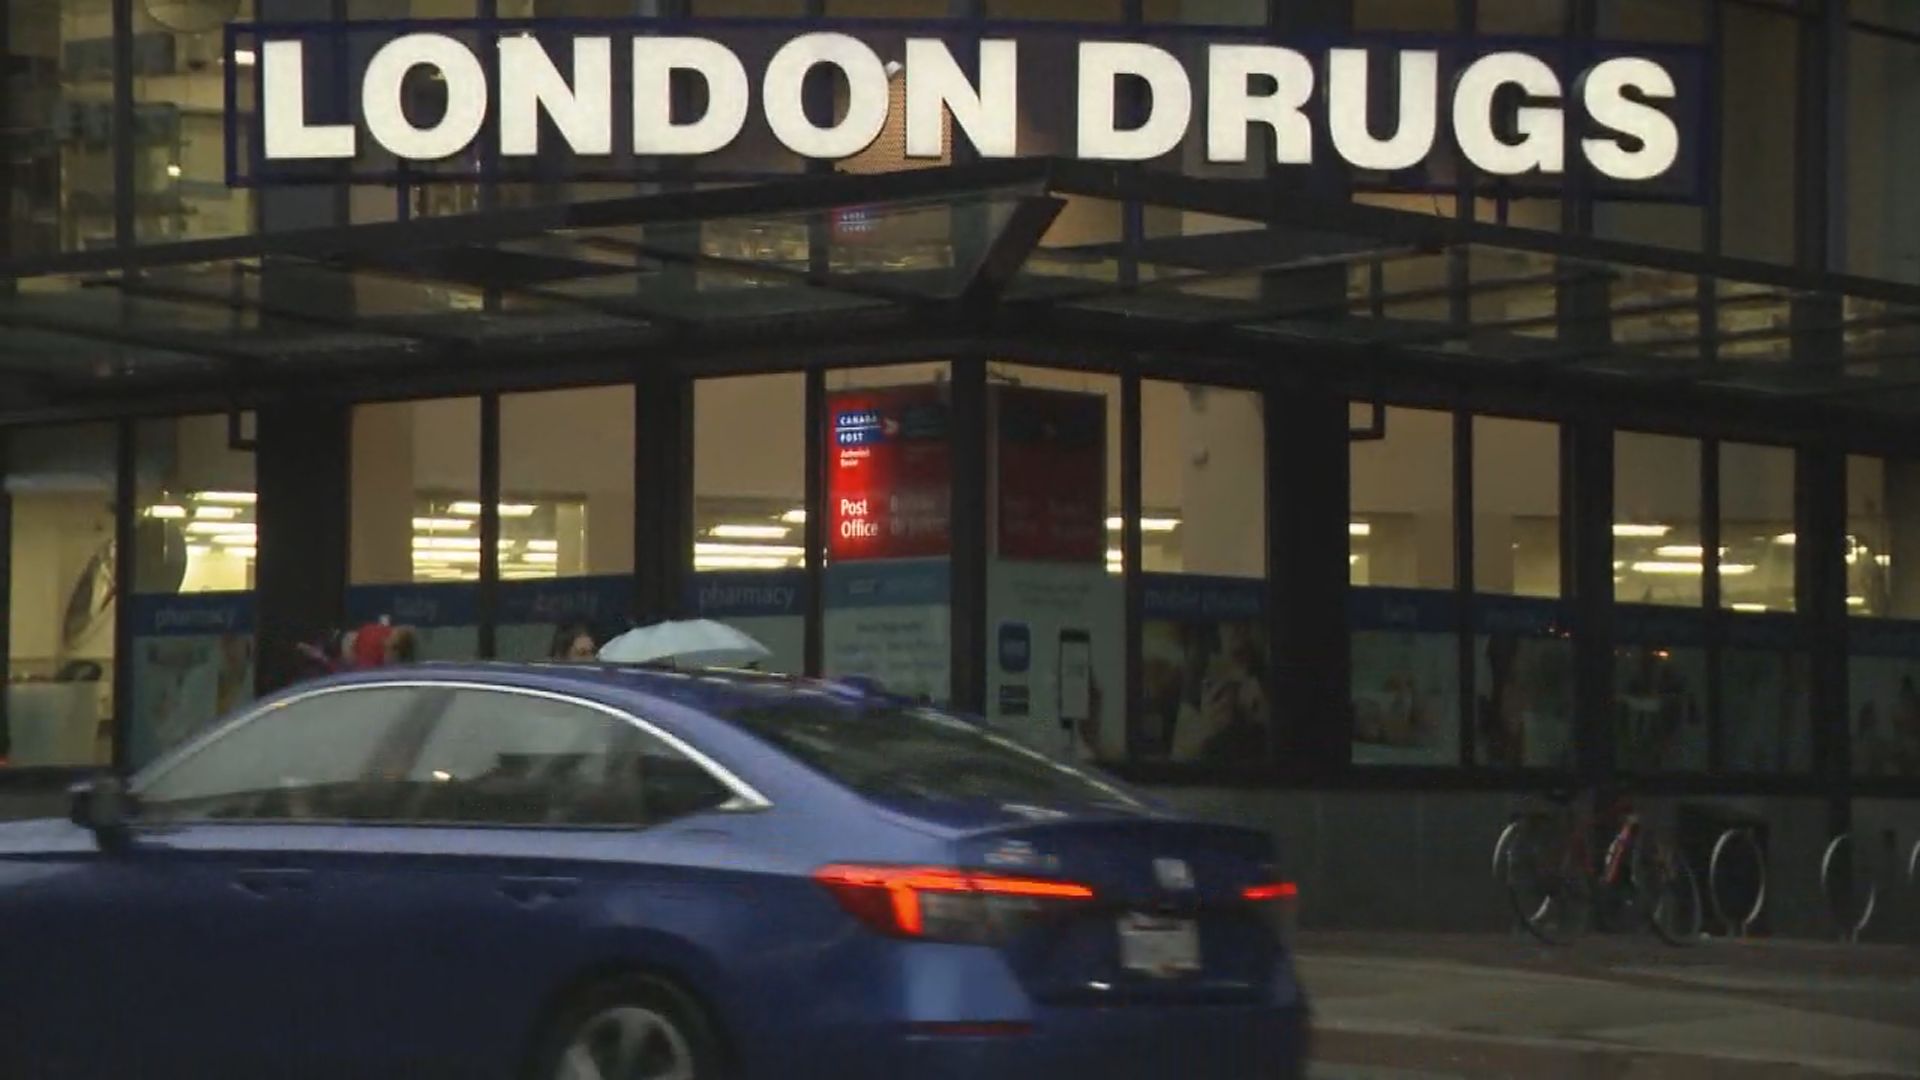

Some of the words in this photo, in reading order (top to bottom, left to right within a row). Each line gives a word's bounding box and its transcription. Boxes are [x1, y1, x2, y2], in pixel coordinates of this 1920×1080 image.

[264, 31, 1017, 160] LONDON
[1078, 41, 1680, 181] DRUGS
[840, 413, 878, 426] CANADA
[840, 432, 864, 443] POST
[840, 499, 868, 516] Post
[840, 519, 879, 538] Office
[699, 581, 796, 613] pharmacy
